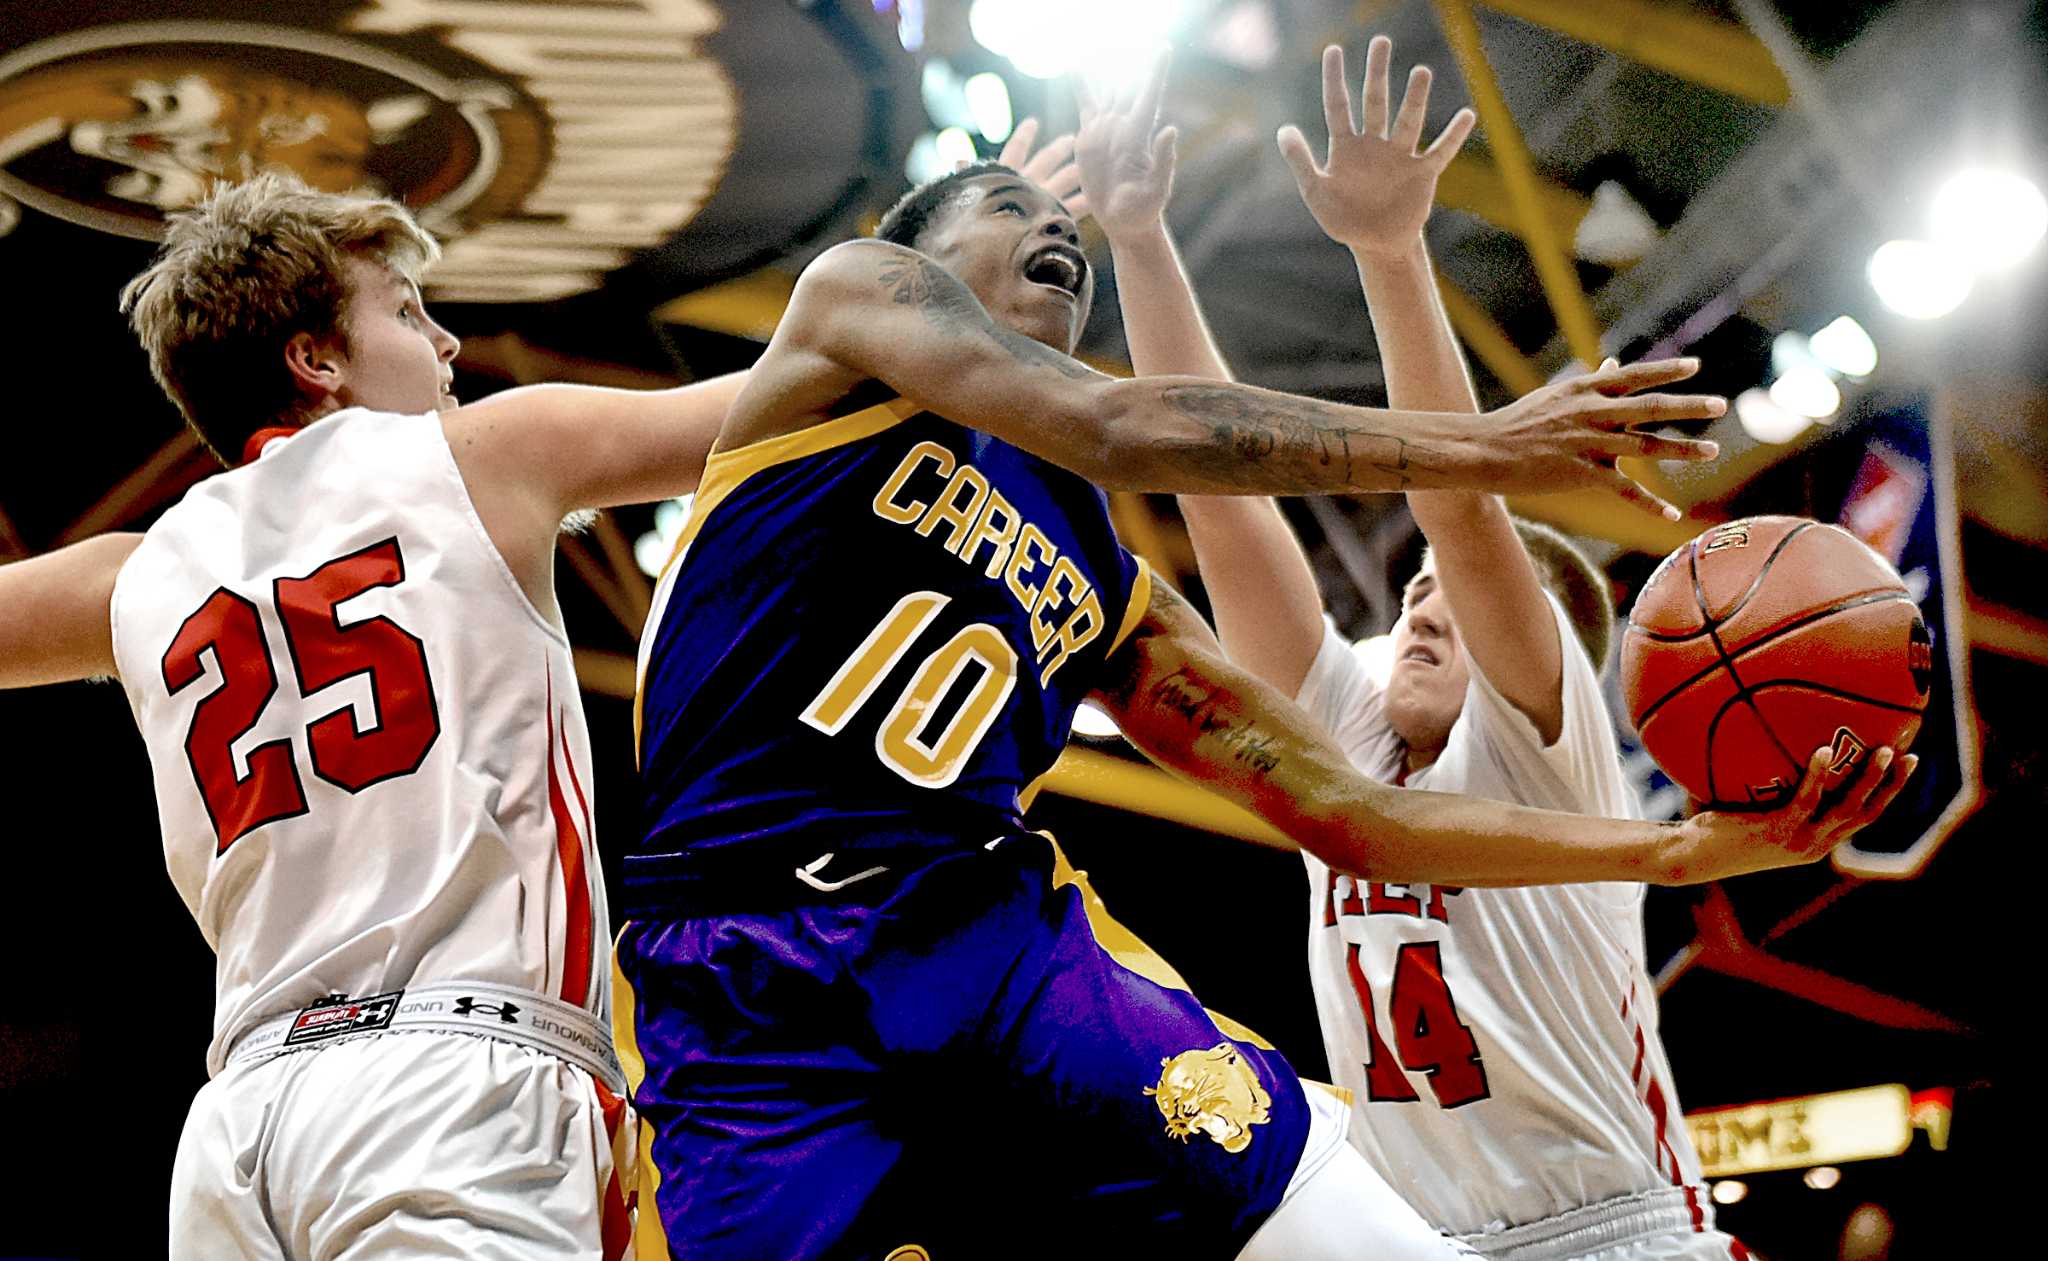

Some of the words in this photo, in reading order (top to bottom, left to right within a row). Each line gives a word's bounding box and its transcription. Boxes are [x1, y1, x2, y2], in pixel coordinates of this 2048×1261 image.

[872, 440, 1104, 690] CAREER
[161, 535, 441, 858] 25
[798, 590, 1018, 789] 10
[397, 1001, 444, 1015] UND
[531, 1015, 608, 1057] ARMOUR
[1346, 940, 1491, 1109] 14
